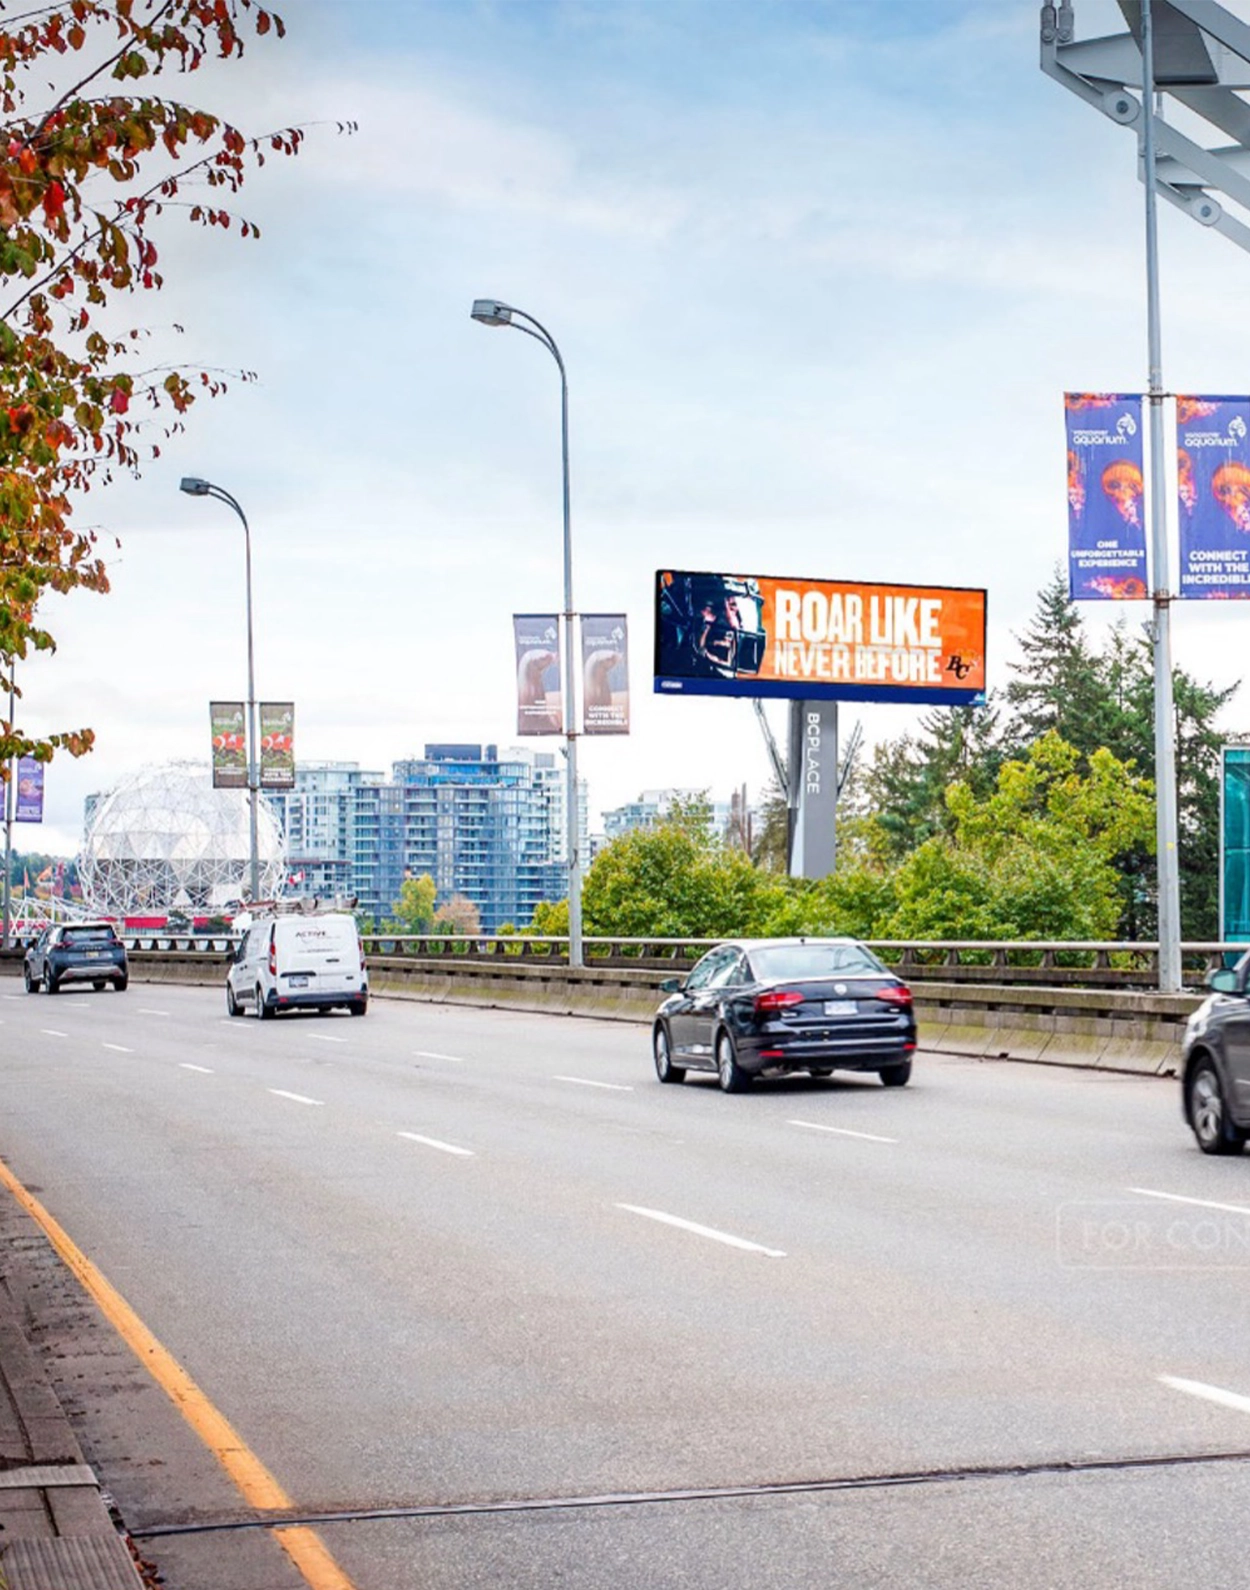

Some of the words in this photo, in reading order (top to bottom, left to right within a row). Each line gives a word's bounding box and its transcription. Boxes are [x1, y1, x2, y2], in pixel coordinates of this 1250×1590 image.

[1071, 550, 1144, 558] UNFORGETTABLE
[1189, 551, 1247, 561] CONNECT
[1078, 559, 1137, 567] EXPERIENCE
[1189, 563, 1222, 573] WITH
[1226, 563, 1249, 572] THE
[775, 590, 863, 643] ROAR
[870, 595, 942, 647] LIKE
[775, 641, 850, 679] NEVER
[854, 645, 942, 682] BEFORE
